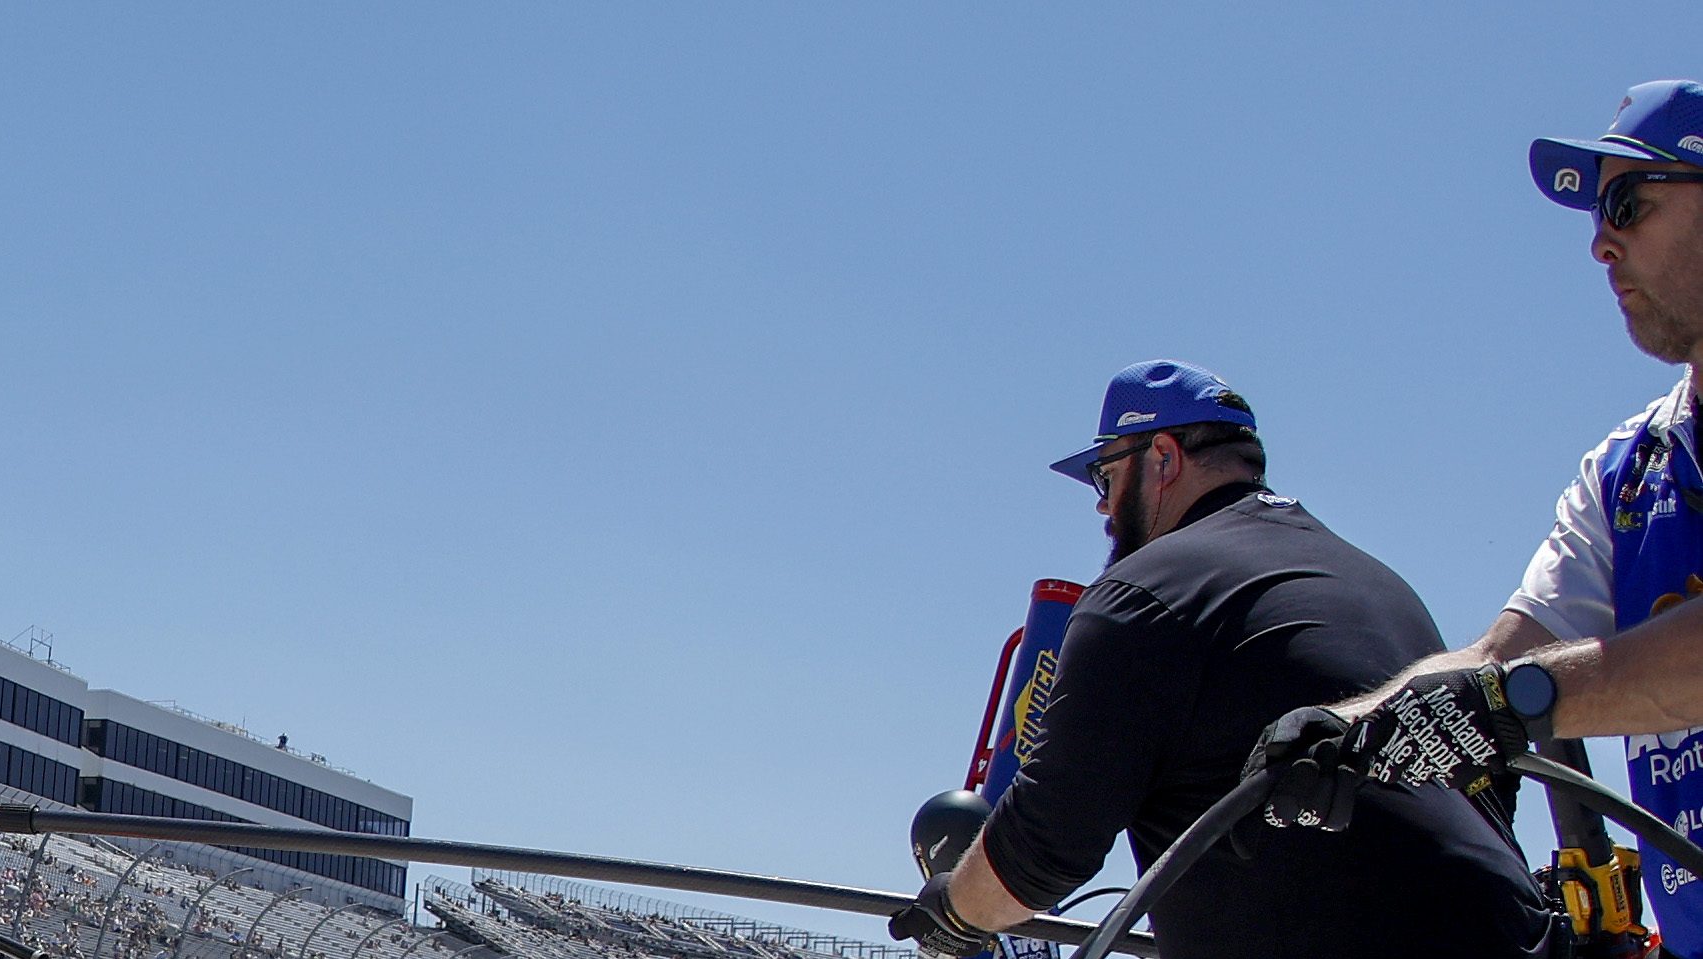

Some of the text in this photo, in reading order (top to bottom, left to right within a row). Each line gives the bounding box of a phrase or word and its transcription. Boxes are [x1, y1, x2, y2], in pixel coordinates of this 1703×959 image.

[1016, 650, 1059, 758] SUNOCO
[1391, 689, 1463, 774] Mechanix
[1424, 684, 1497, 767] Mechanix
